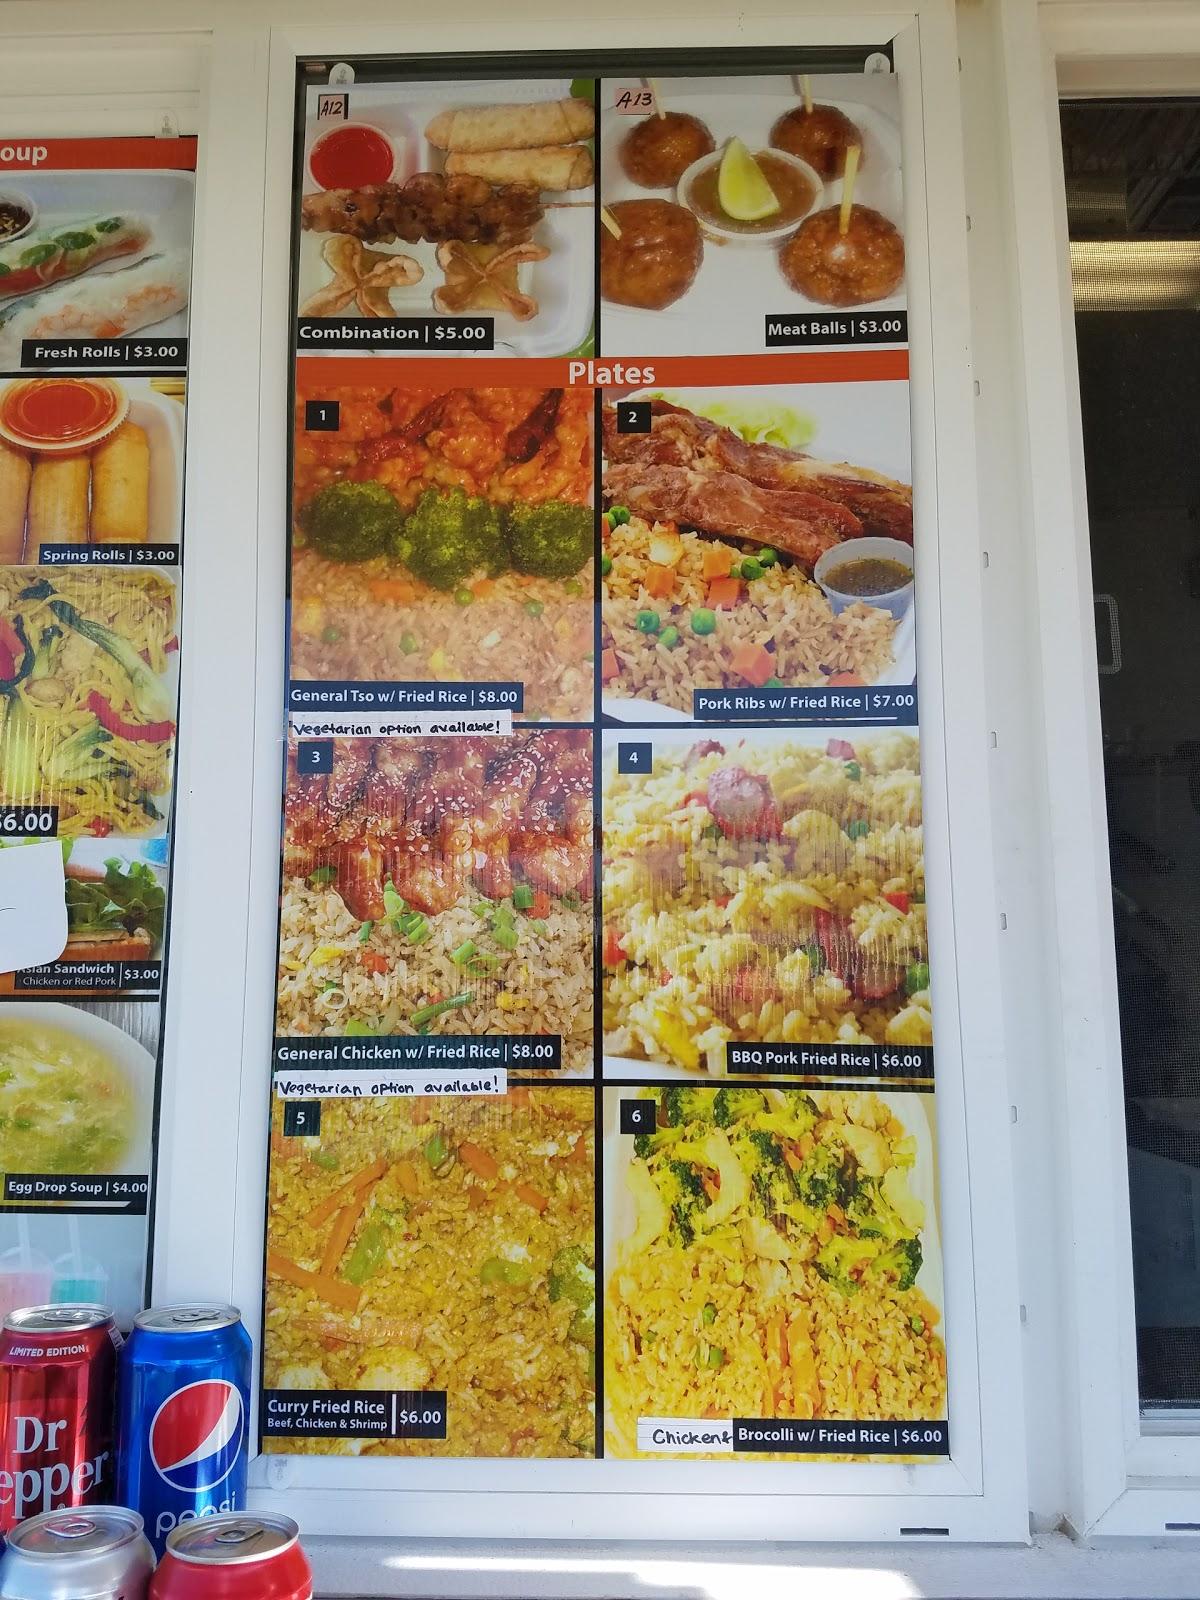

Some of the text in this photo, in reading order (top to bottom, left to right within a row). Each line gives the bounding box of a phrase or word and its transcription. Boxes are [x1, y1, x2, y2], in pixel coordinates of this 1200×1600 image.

[320, 99, 343, 116] A12
[615, 91, 652, 109] A13
[299, 325, 486, 340] Combination $5.00
[768, 319, 902, 336] Meat Balls $3.00
[34, 346, 179, 359] Fresh Rolls $3.00
[569, 360, 656, 385] Plates
[319, 409, 326, 421] 1
[628, 411, 637, 423] 2
[43, 550, 175, 563] Spring Rolls $3.00
[290, 689, 518, 704] General Tso w/ Fried Rice $8.00
[699, 694, 915, 710] Pork Ribs w/ Fried Rice $7.00
[293, 720, 501, 736] Vegetarian option available!
[311, 751, 321, 763] 3
[628, 751, 639, 764] 4
[0, 813, 53, 832] 6.00
[54, 963, 115, 974] Sandwich
[124, 969, 160, 981] $3.00
[23, 976, 117, 986] Chicken or Red Pork
[277, 1044, 554, 1061] General Chicken w/ Fried Rice $8.00
[732, 1050, 922, 1068] BBQ Pork Fried Rice $6.00
[280, 1075, 499, 1096] Vegetarian option available!
[296, 1112, 305, 1125] 5
[631, 1110, 641, 1123] 6
[8, 1181, 148, 1196] Egg Drop Soup $4.00
[9, 1346, 44, 1357] LIMITED
[267, 1399, 385, 1416] Curry Fried Rice
[267, 1417, 388, 1431] Beef, Chicken & Shrimp
[399, 1410, 442, 1425] $6.00
[12, 1416, 68, 1454] Dr
[738, 1427, 942, 1444] Brocolli w/ Fried Rice $6.00
